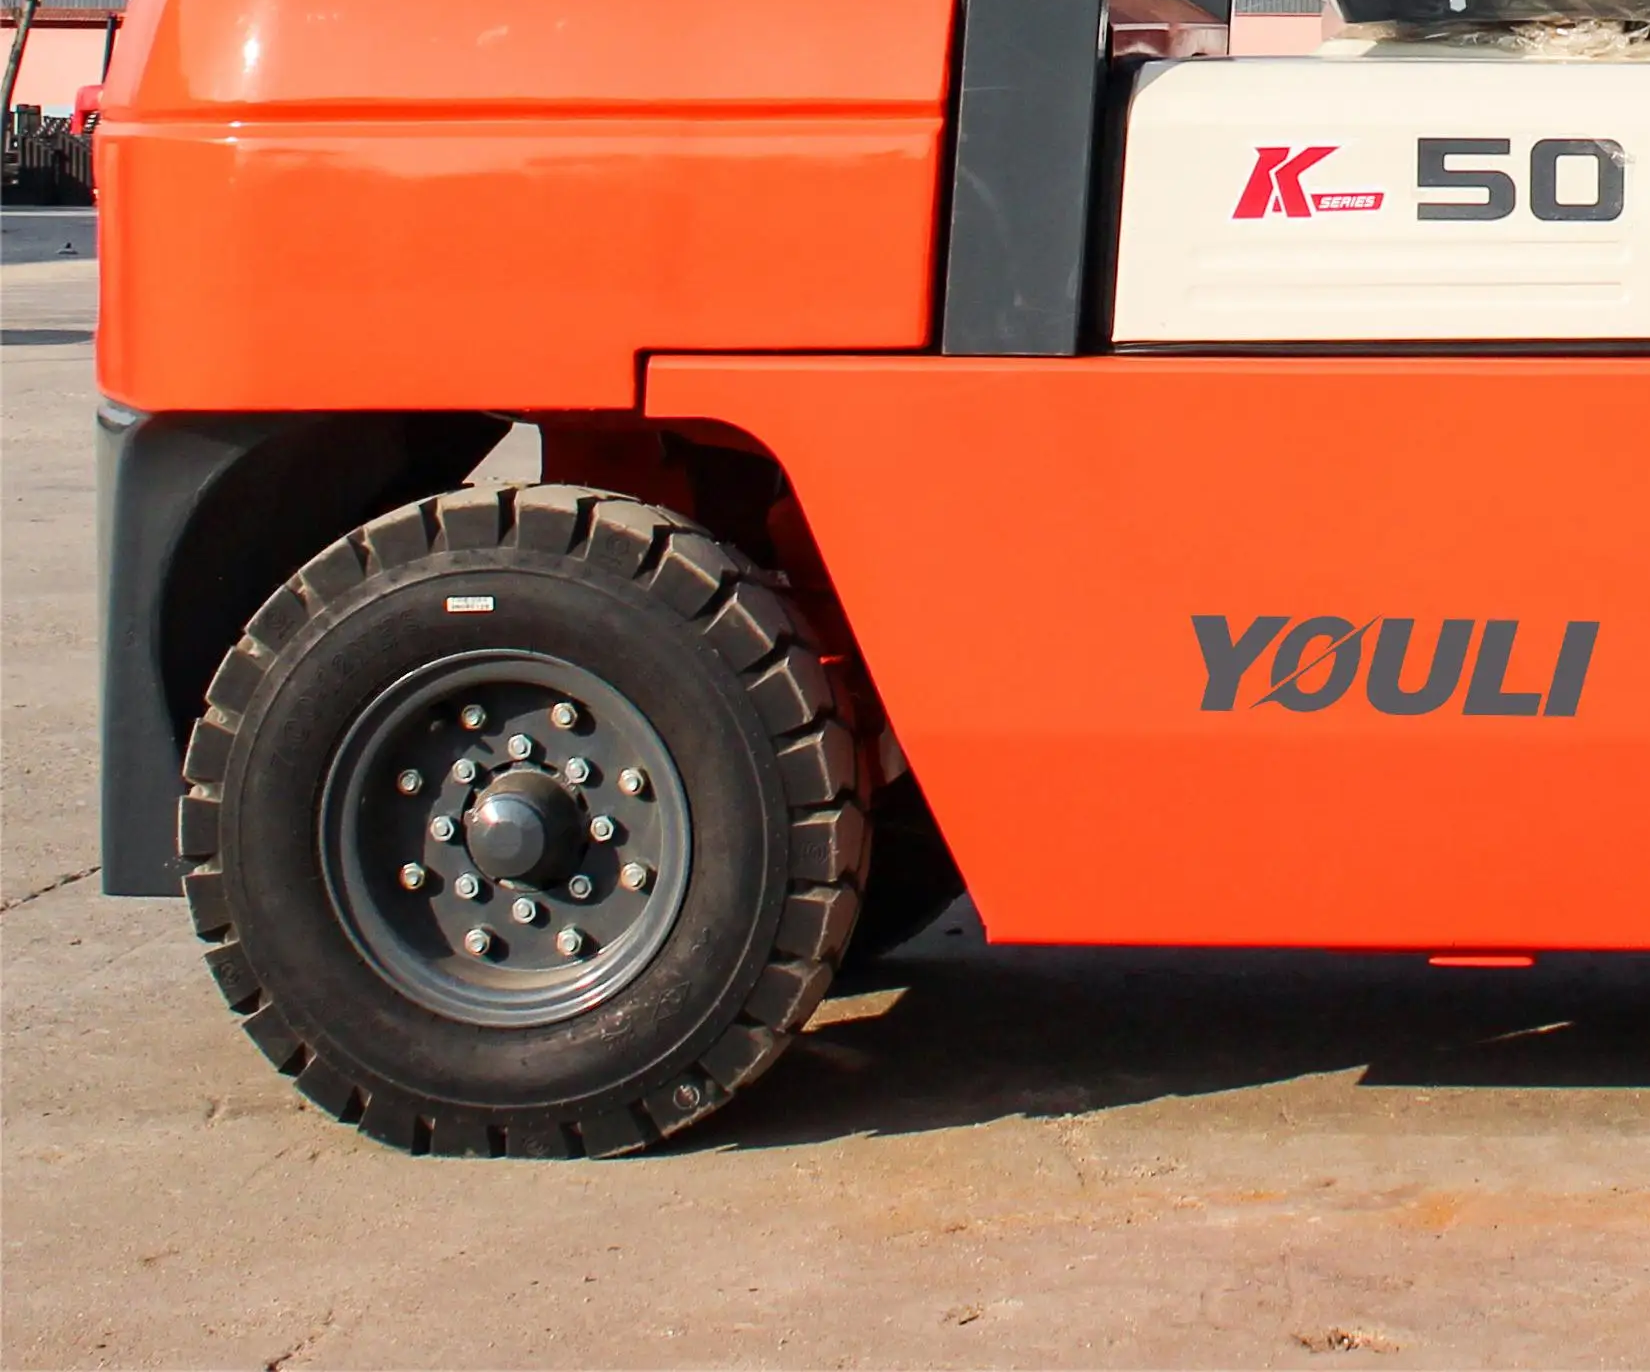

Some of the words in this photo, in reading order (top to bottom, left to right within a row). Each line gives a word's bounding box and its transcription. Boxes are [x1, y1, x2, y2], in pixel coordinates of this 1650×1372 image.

[1231, 145, 1341, 219] K
[1318, 195, 1376, 209] SERIES
[1416, 137, 1625, 221] 50
[1190, 614, 1600, 717] YOULI
